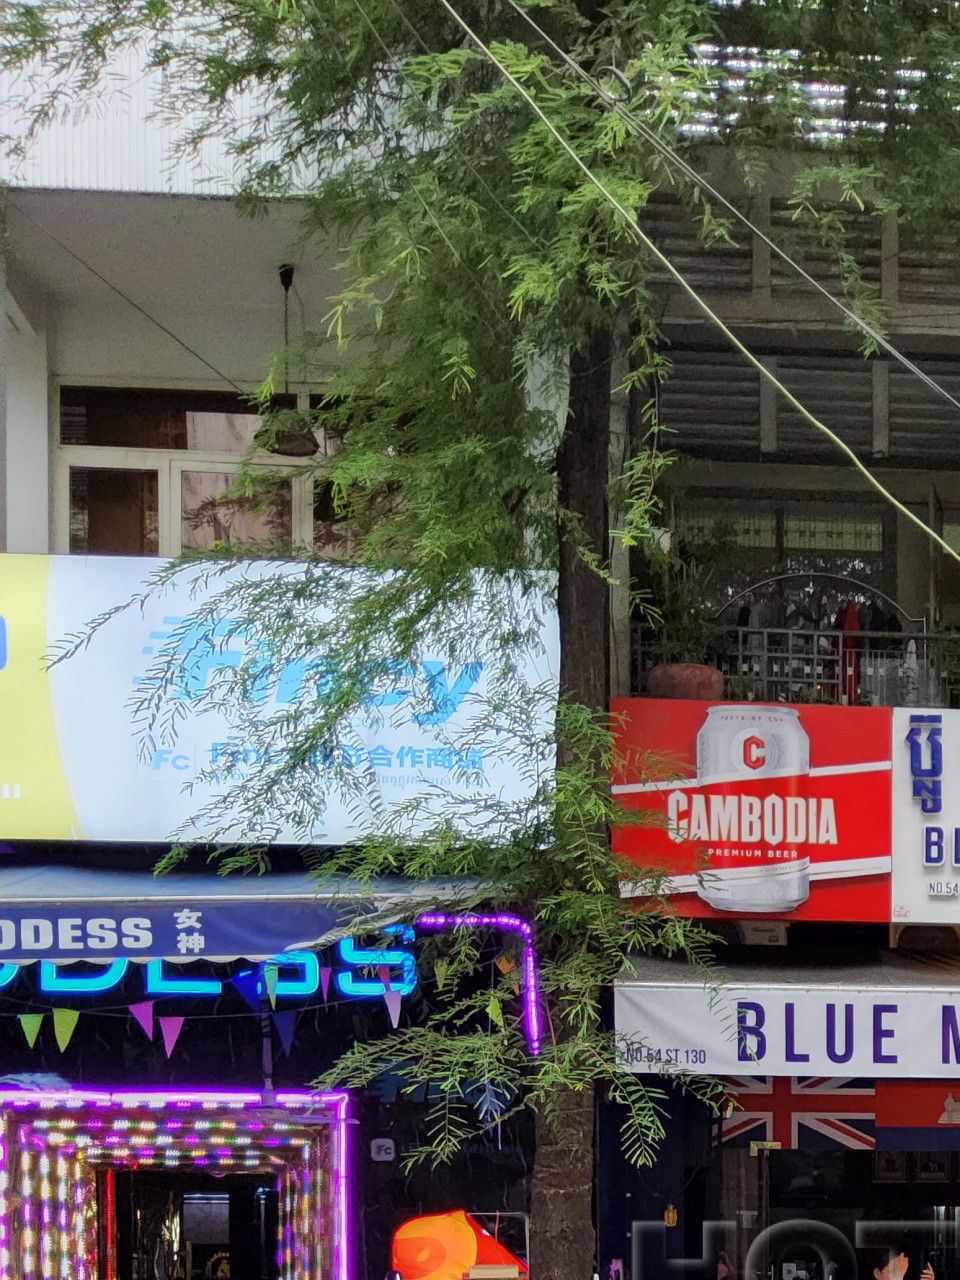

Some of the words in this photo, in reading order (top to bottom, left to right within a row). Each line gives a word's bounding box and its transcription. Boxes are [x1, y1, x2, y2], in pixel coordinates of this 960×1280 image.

[667, 790, 839, 845] CAMBODIA
[708, 848, 762, 857] PREMIUM
[768, 850, 798, 858] BEER
[929, 883, 959, 896] NO.54
[173, 908, 206, 954] 女神
[737, 1002, 898, 1065] BLUE
